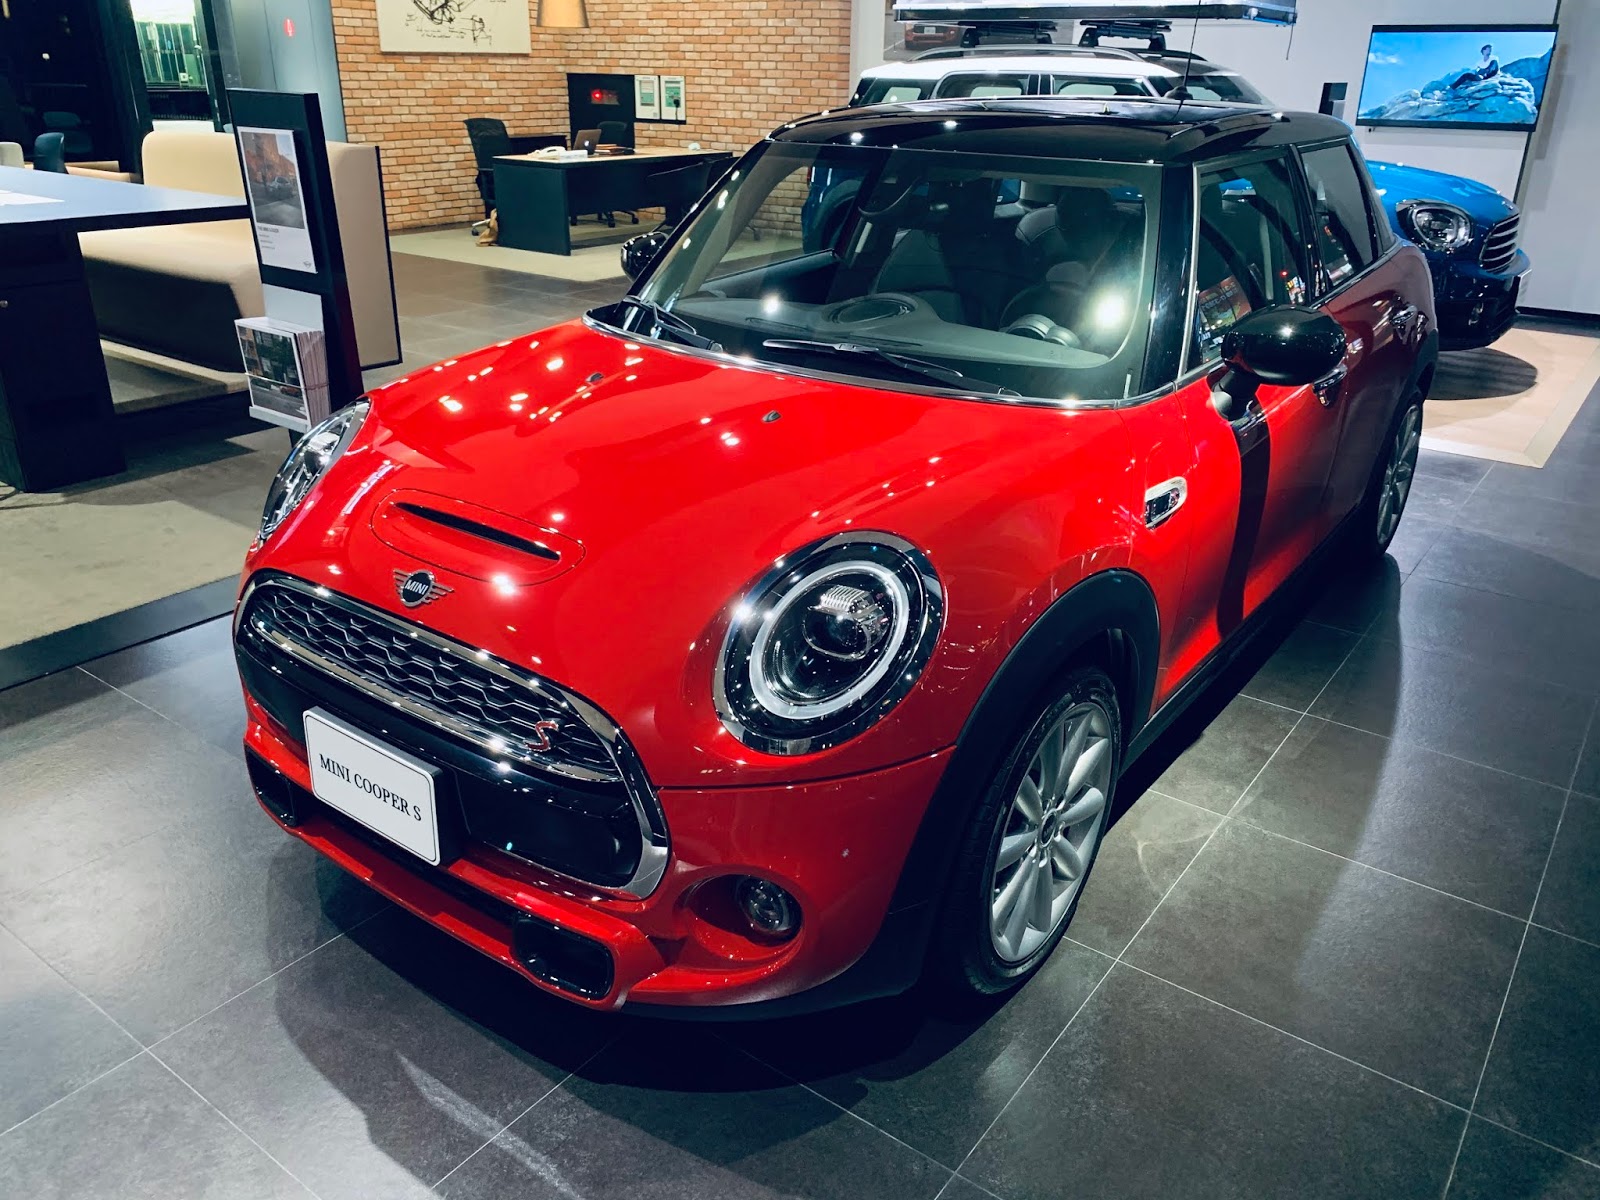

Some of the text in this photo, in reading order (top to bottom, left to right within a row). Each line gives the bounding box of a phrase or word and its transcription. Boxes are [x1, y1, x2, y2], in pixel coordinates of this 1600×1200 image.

[405, 580, 429, 596] MINI
[524, 720, 559, 752] S
[319, 753, 422, 821] MINI COOPER S
